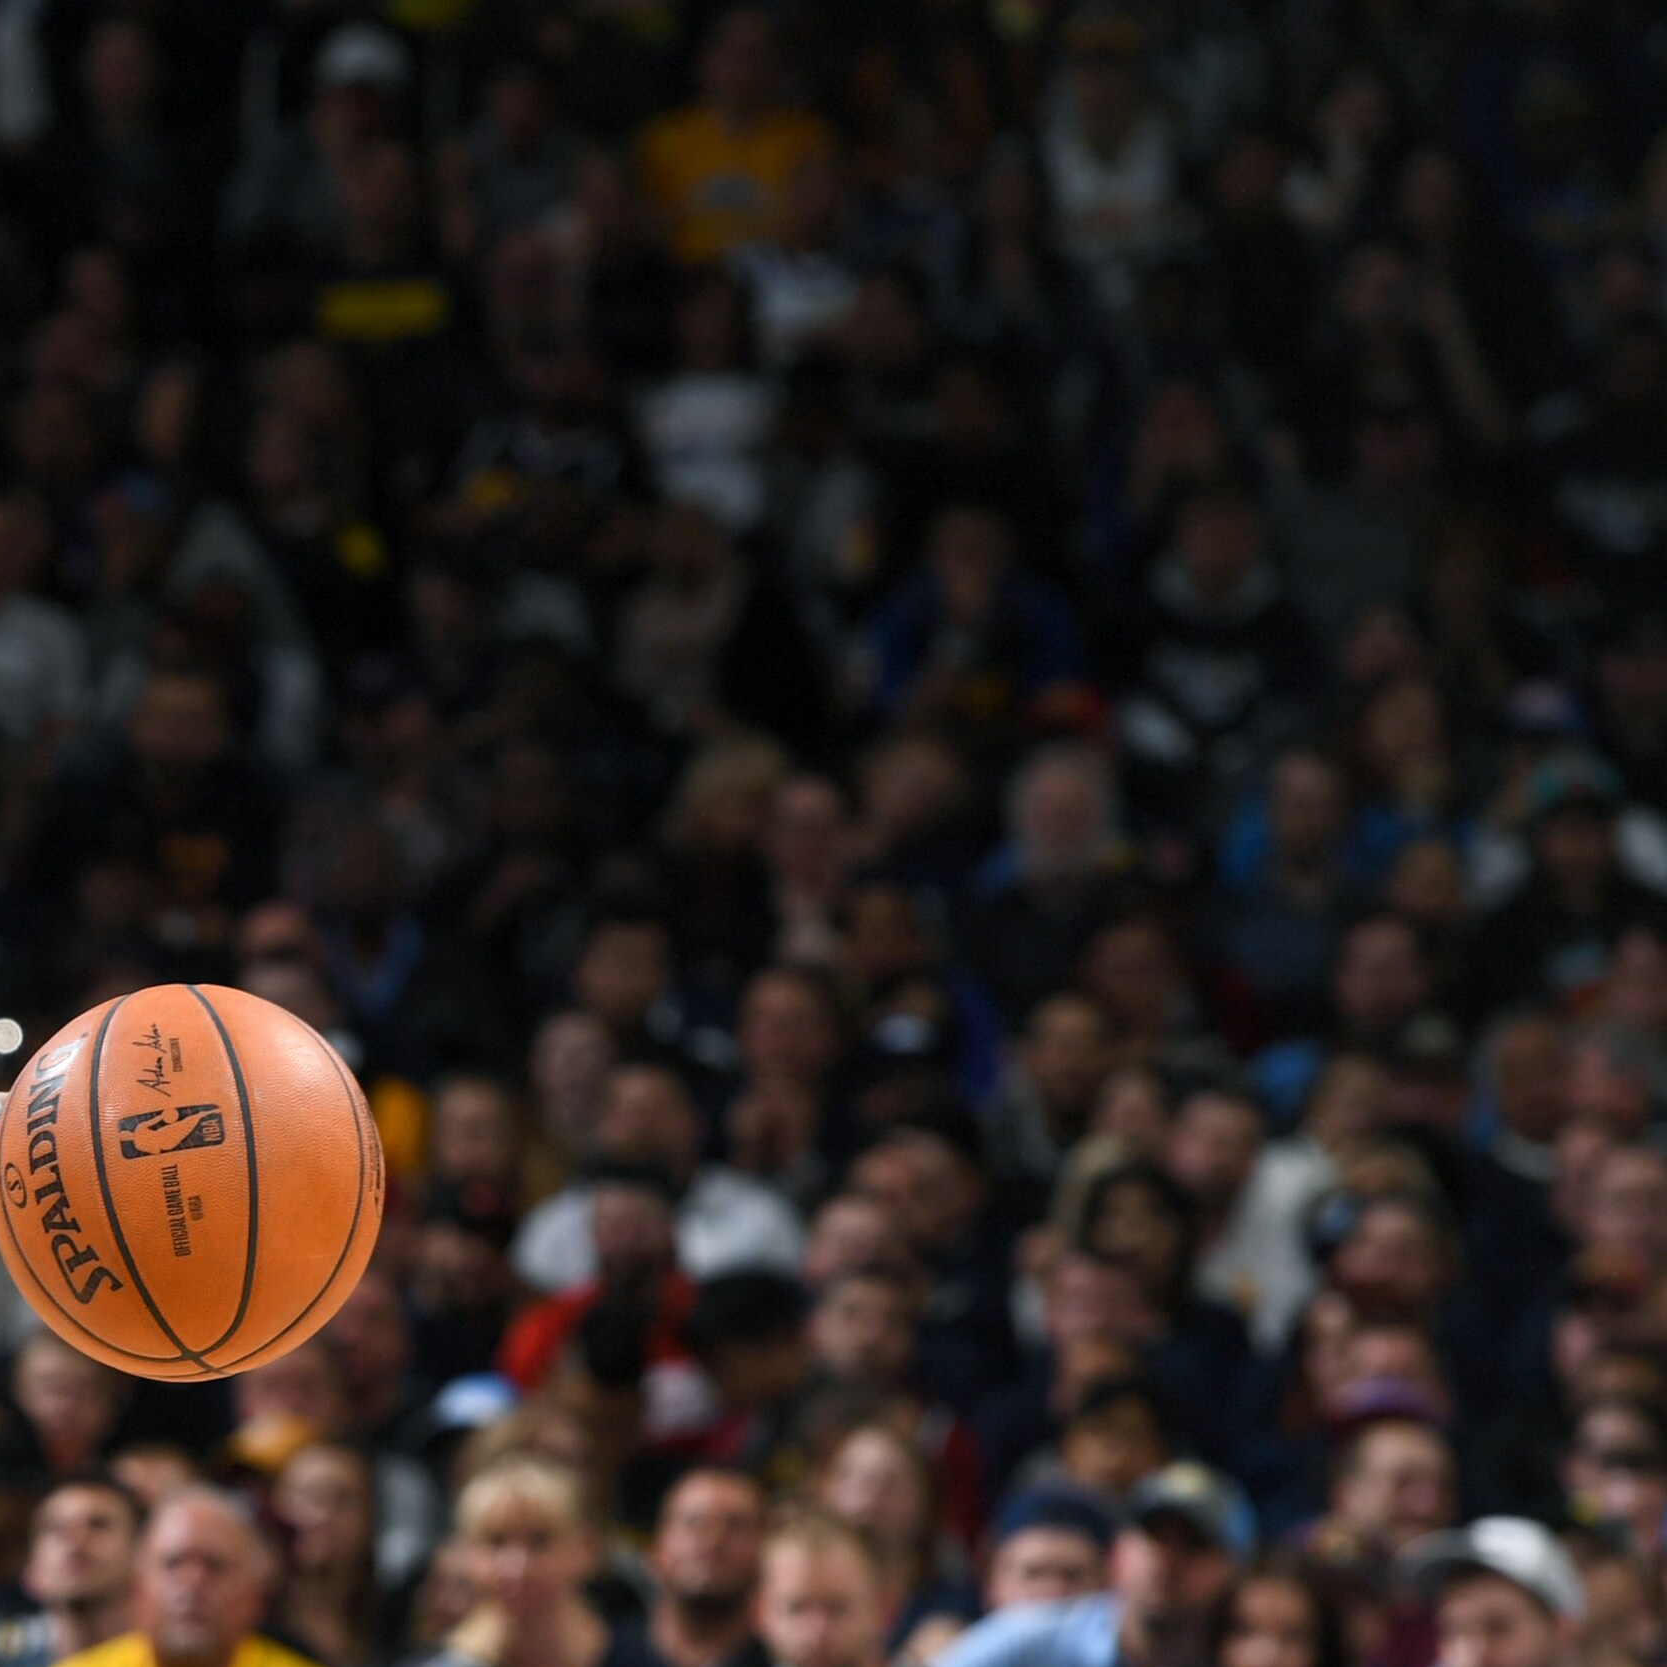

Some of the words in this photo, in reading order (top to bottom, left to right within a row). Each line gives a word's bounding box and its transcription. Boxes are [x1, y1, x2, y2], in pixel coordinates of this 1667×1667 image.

[202, 1118, 222, 1143] NBA
[26, 1036, 124, 1305] SPALDING
[161, 1164, 180, 1188] BALL
[163, 1189, 185, 1217] GAME
[169, 1217, 192, 1258] OFFICIAL
